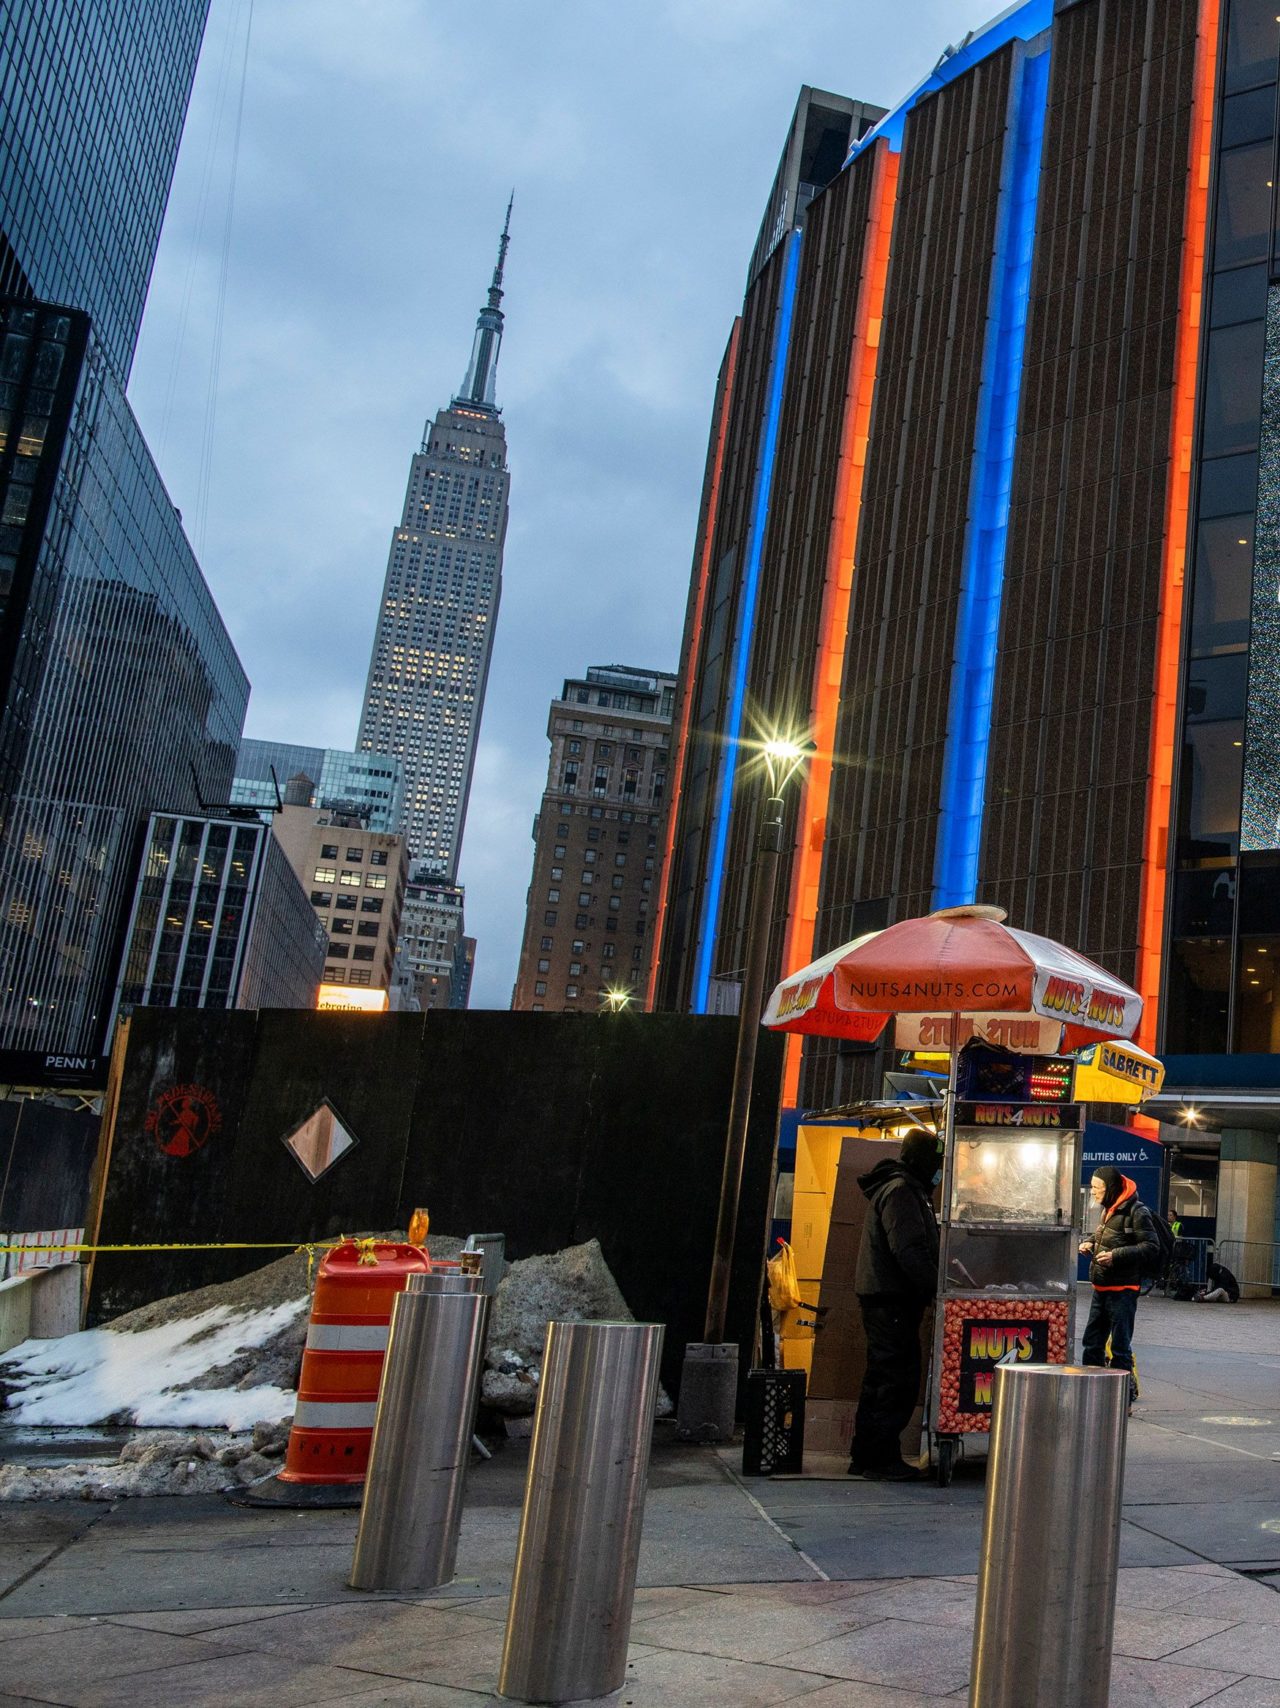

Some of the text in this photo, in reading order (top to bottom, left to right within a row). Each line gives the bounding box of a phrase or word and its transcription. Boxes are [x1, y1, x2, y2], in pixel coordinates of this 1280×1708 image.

[850, 983, 1018, 998] NUTS4NUTS.COM
[46, 1055, 97, 1071] PENN 1
[1102, 1048, 1159, 1085] SABRETT
[1082, 1152, 1138, 1161] BILITIES ONLY
[970, 1326, 1034, 1360] NUTS
